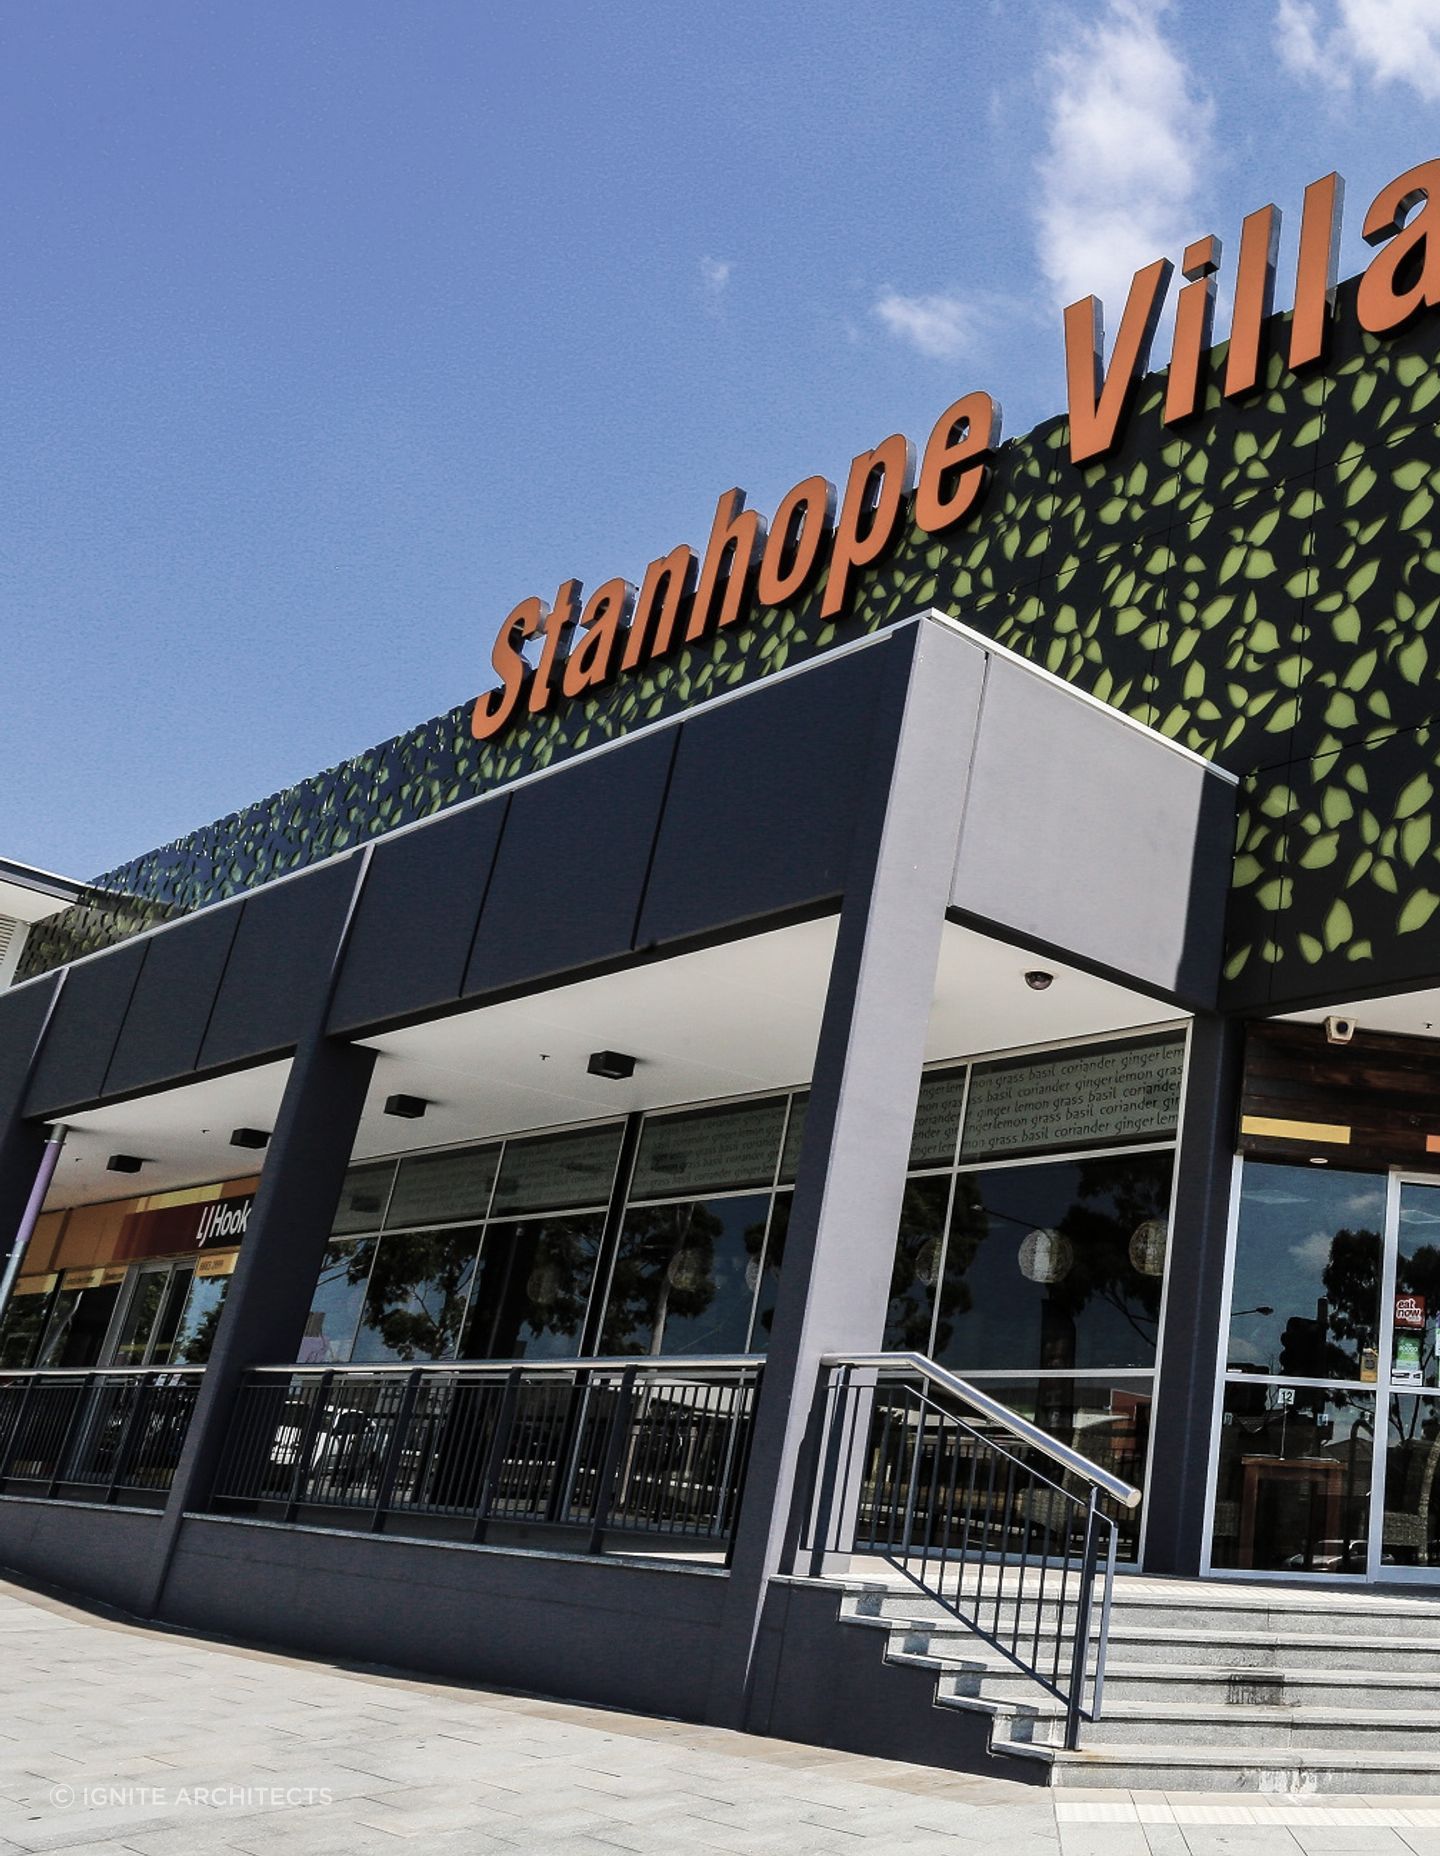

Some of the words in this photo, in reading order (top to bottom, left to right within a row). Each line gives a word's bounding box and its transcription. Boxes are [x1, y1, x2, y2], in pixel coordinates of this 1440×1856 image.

[471, 390, 1001, 740] Stanhope
[1060, 1055, 1116, 1075] coriander
[1054, 1118, 1109, 1138] coriander
[1396, 1297, 1416, 1310] eat
[1396, 1307, 1423, 1321] now
[1281, 1390, 1293, 1402] 12
